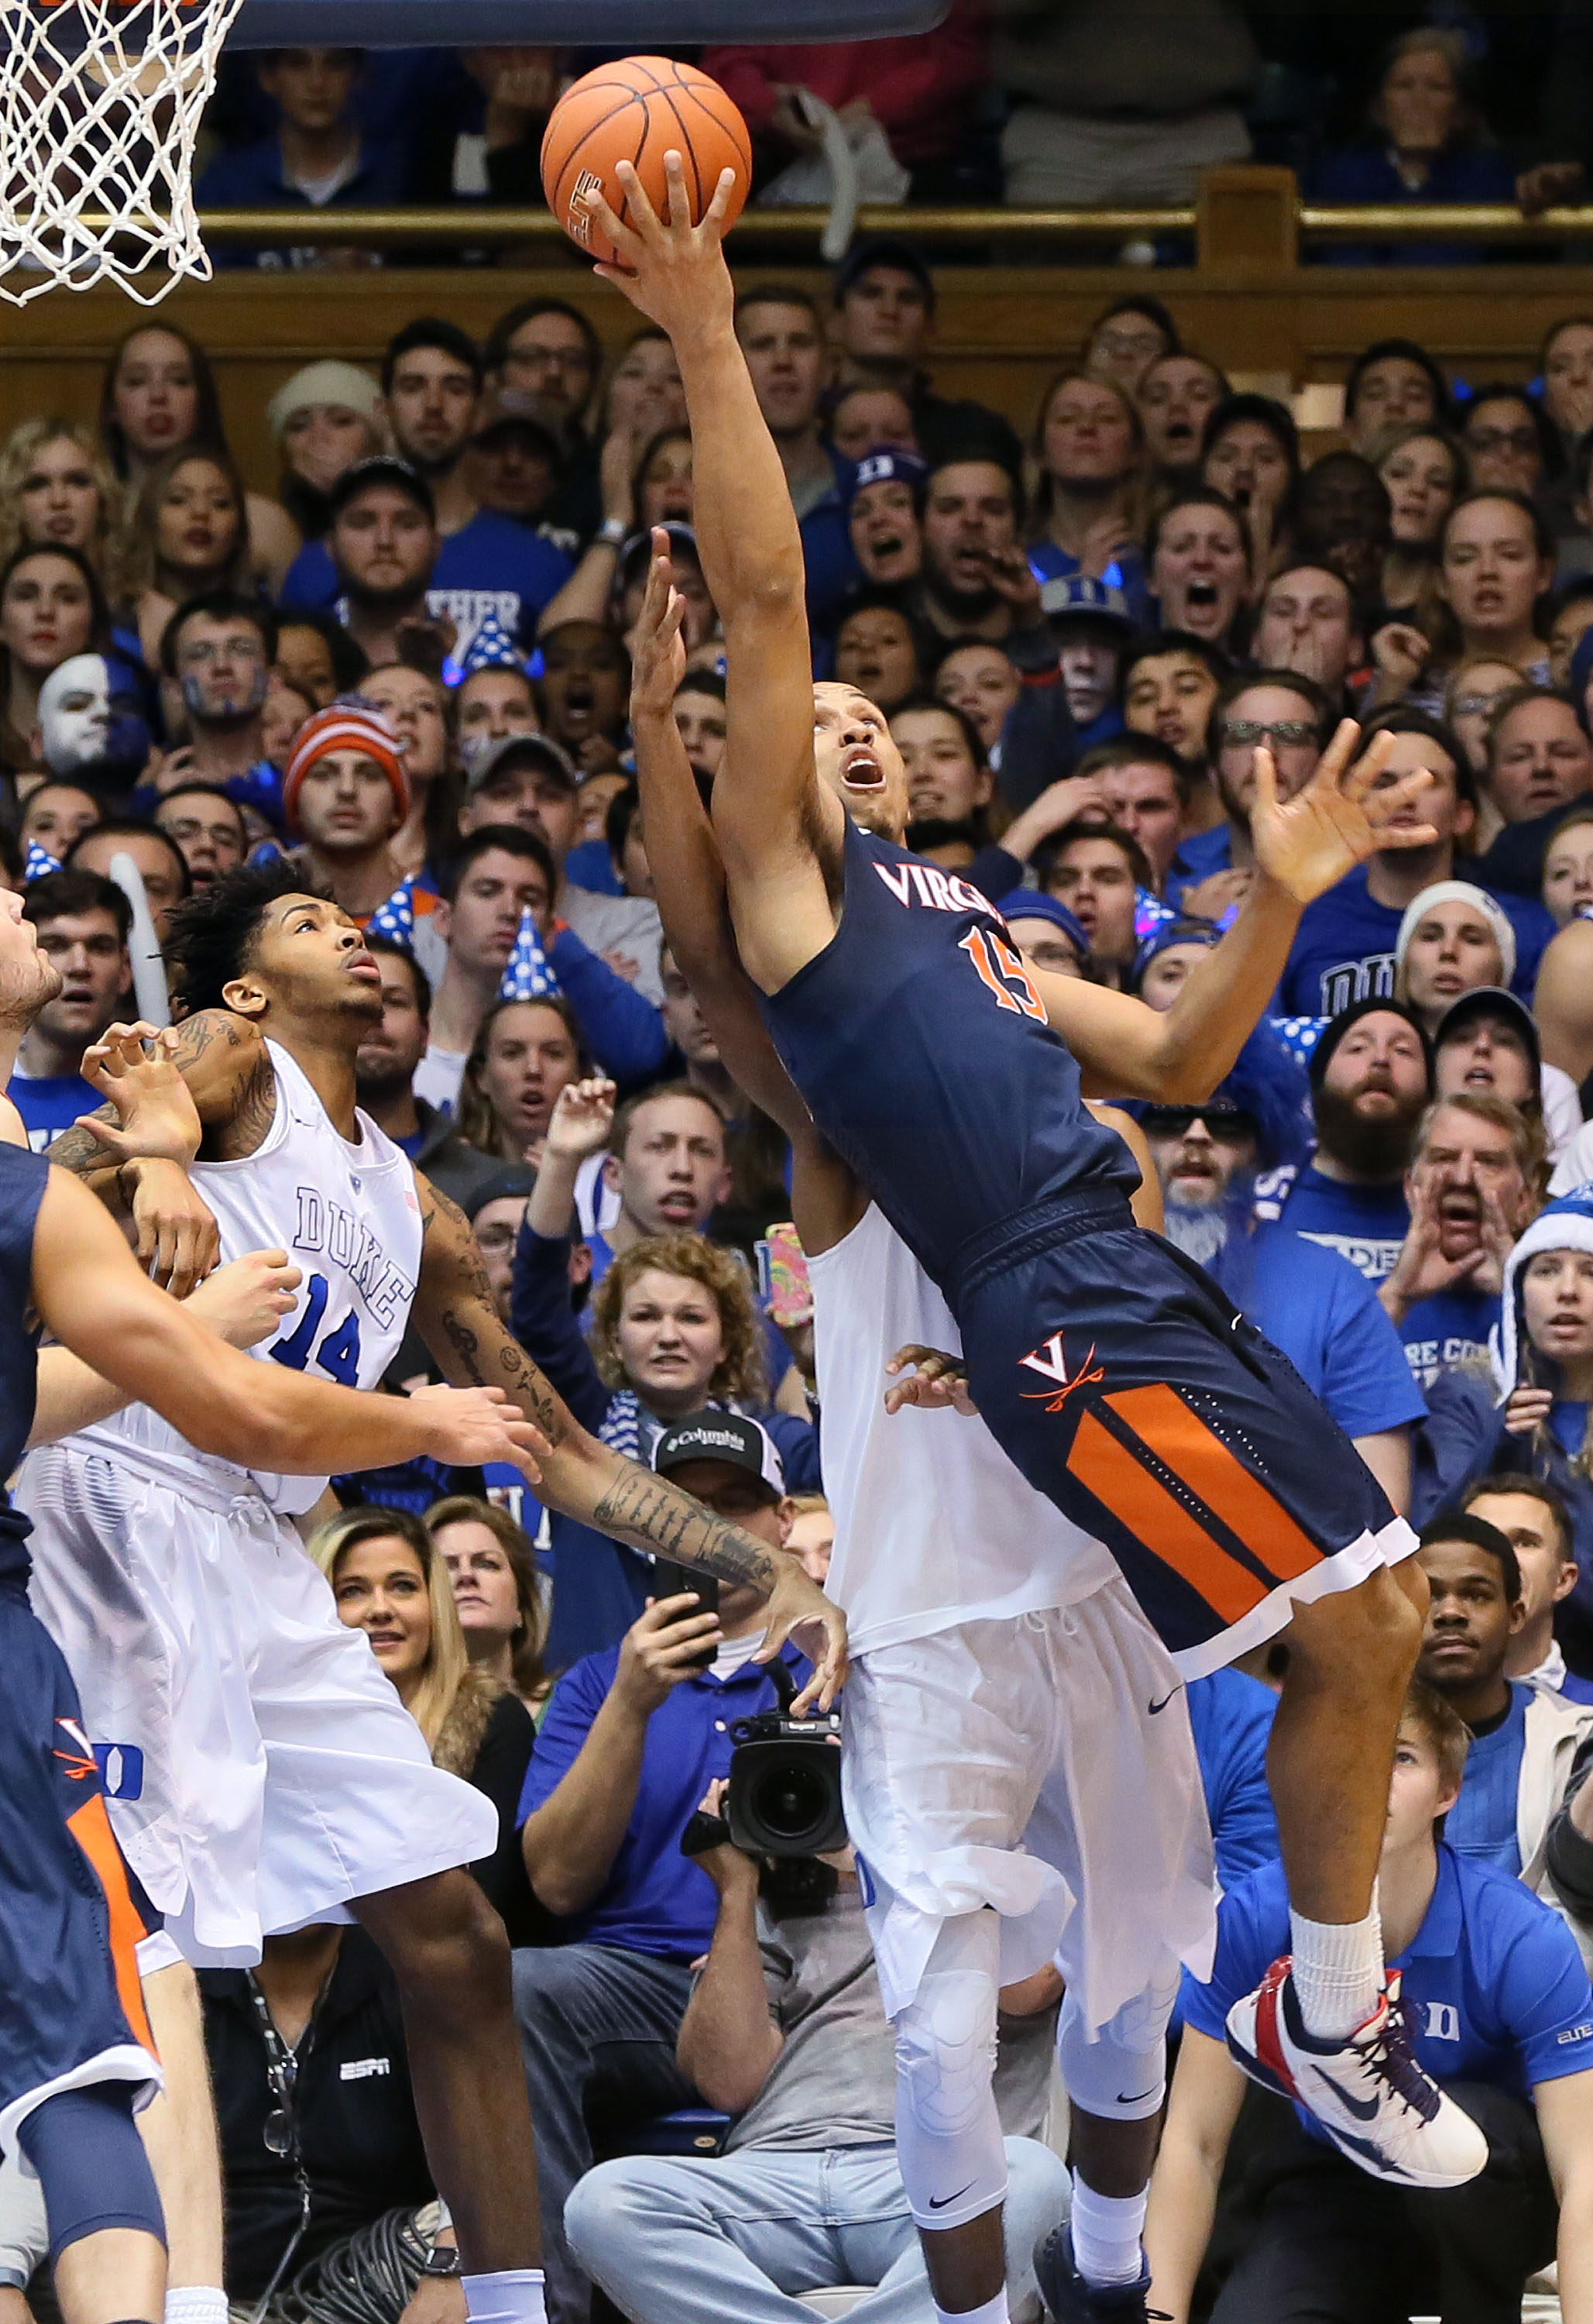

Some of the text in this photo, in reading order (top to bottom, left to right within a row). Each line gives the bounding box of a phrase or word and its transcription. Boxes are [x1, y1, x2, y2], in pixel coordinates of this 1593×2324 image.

[957, 925, 1049, 1026] 15
[293, 1187, 417, 1331] DUKE
[268, 1273, 361, 1387] 14
[339, 2057, 390, 2081] ESPN
[1424, 2002, 1460, 2042] D
